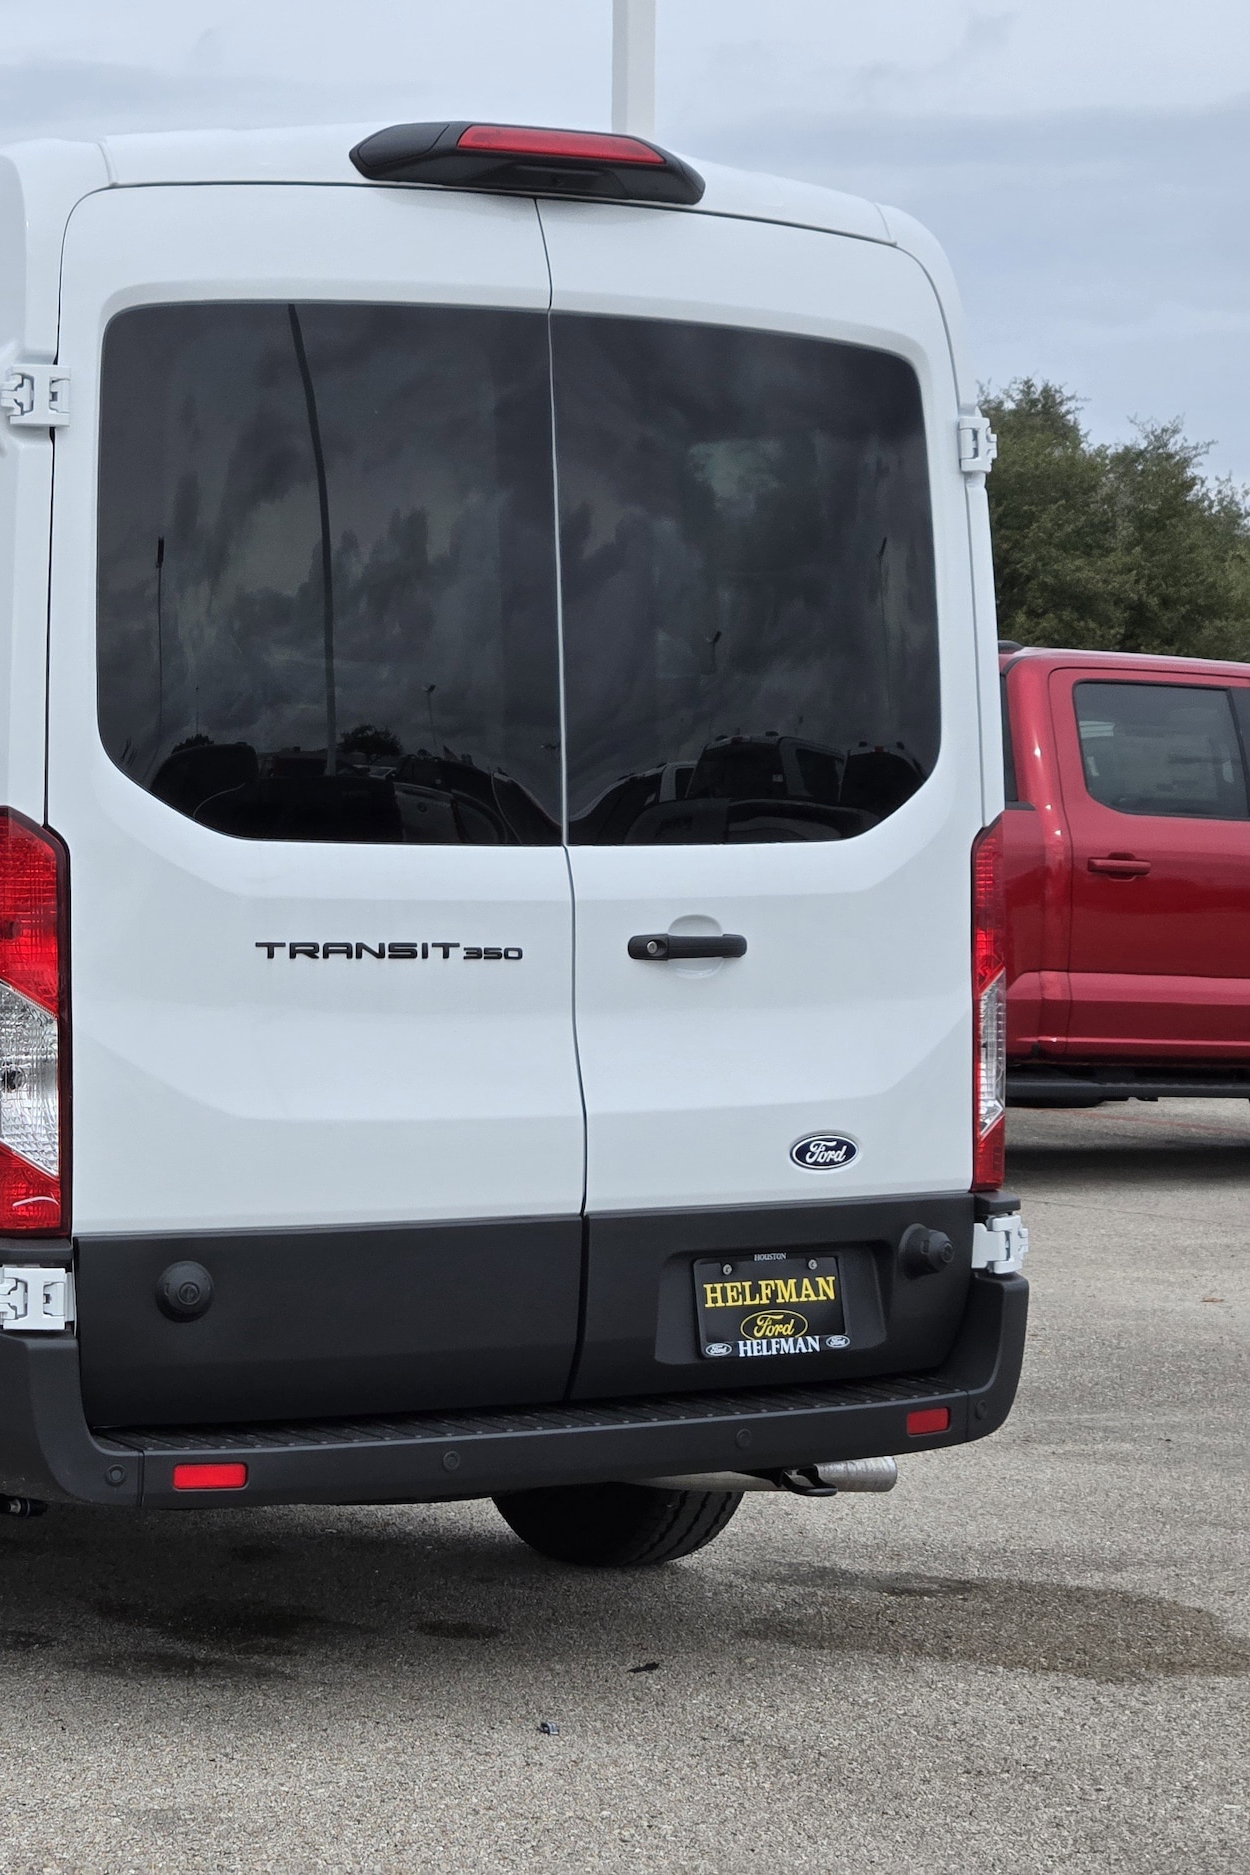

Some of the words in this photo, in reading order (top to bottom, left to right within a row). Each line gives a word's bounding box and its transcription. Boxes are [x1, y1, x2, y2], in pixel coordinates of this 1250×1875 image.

[255, 942, 461, 960] TRANSIT
[463, 946, 523, 960] 350
[805, 1140, 848, 1163] Ford
[754, 1252, 787, 1262] HOUSTON
[703, 1276, 836, 1308] HELFMAN
[753, 1314, 795, 1338] Ford
[737, 1335, 821, 1358] HELFMAN
